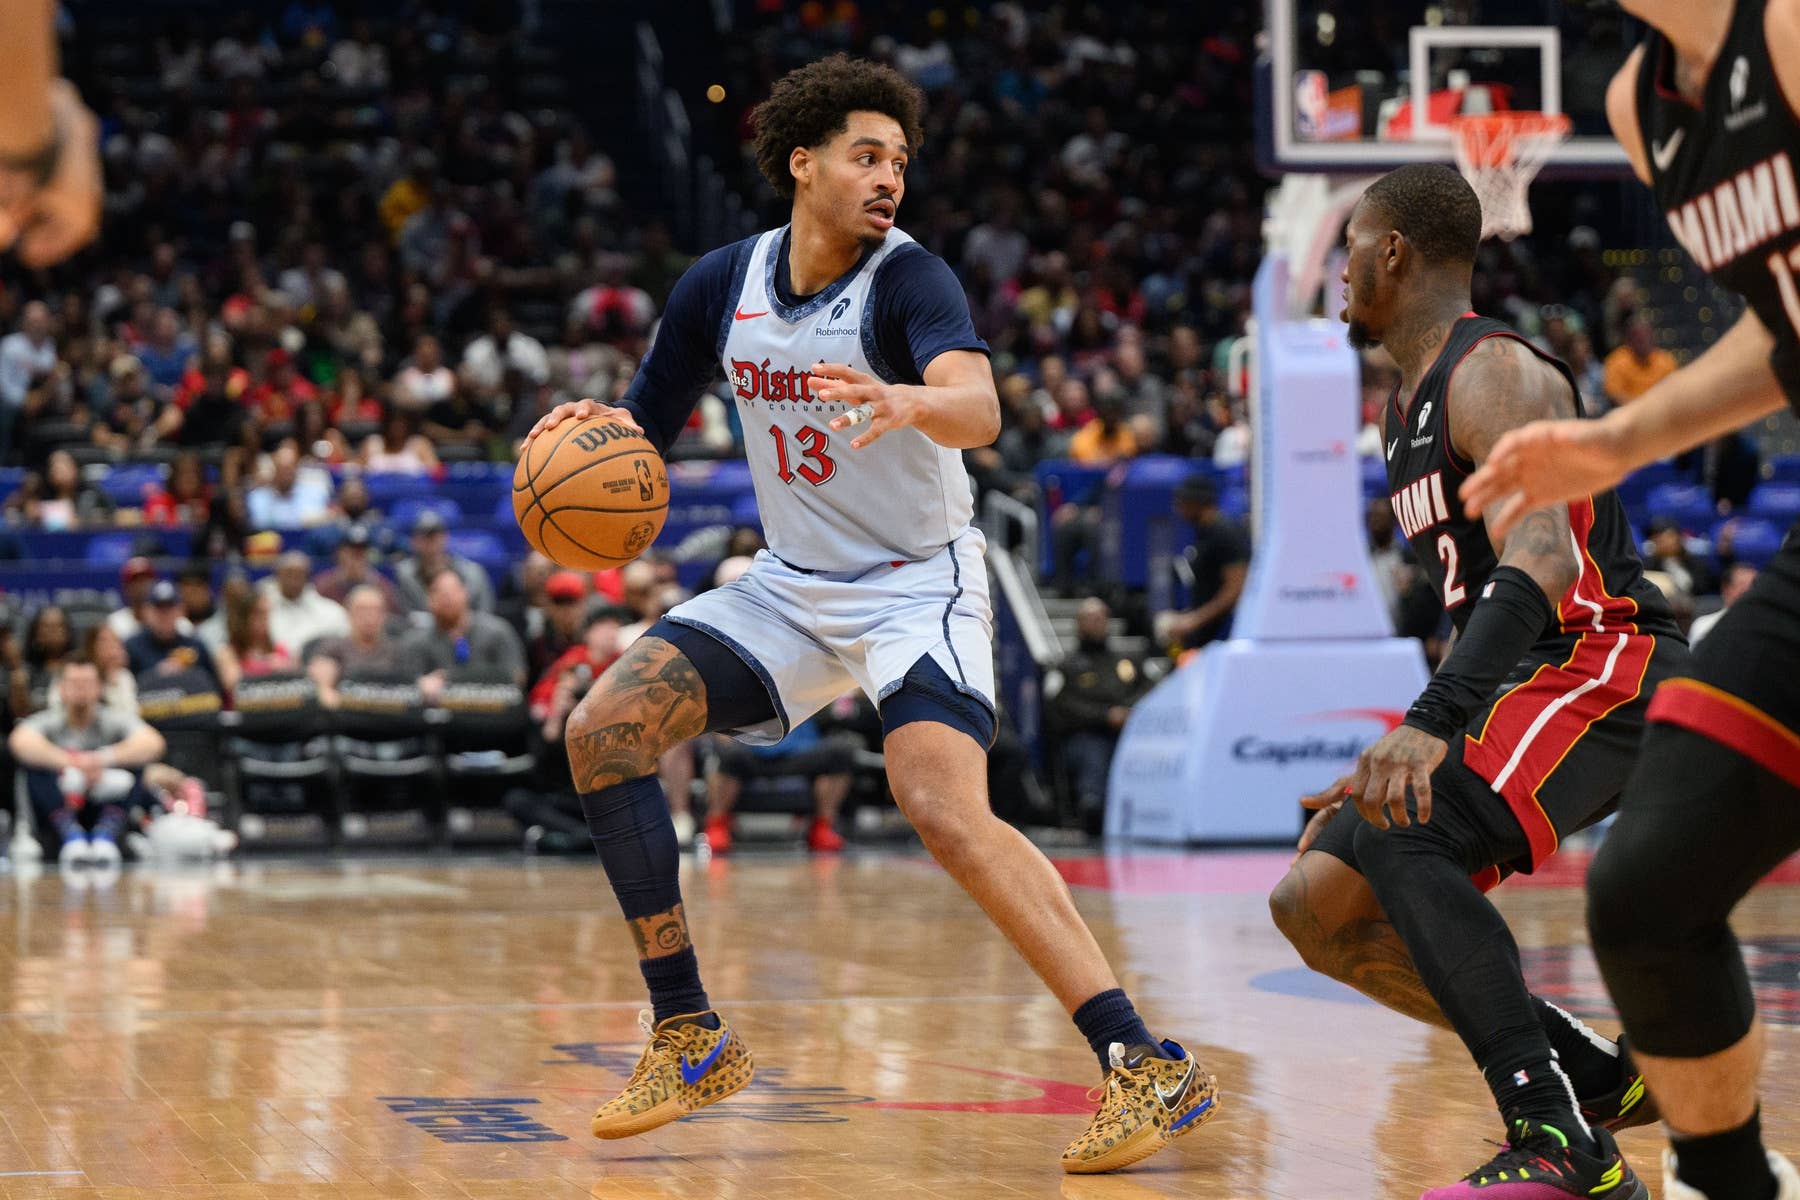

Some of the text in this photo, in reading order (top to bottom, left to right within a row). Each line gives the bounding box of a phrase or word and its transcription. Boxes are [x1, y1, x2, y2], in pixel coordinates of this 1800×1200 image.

[1666, 151, 1800, 273] MIAMI
[815, 327, 858, 336] Robinhood
[730, 369, 748, 387] the
[731, 357, 852, 403] Distr
[769, 403, 847, 412] COLUMBI
[768, 424, 837, 486] 13
[1437, 531, 1467, 610] 2
